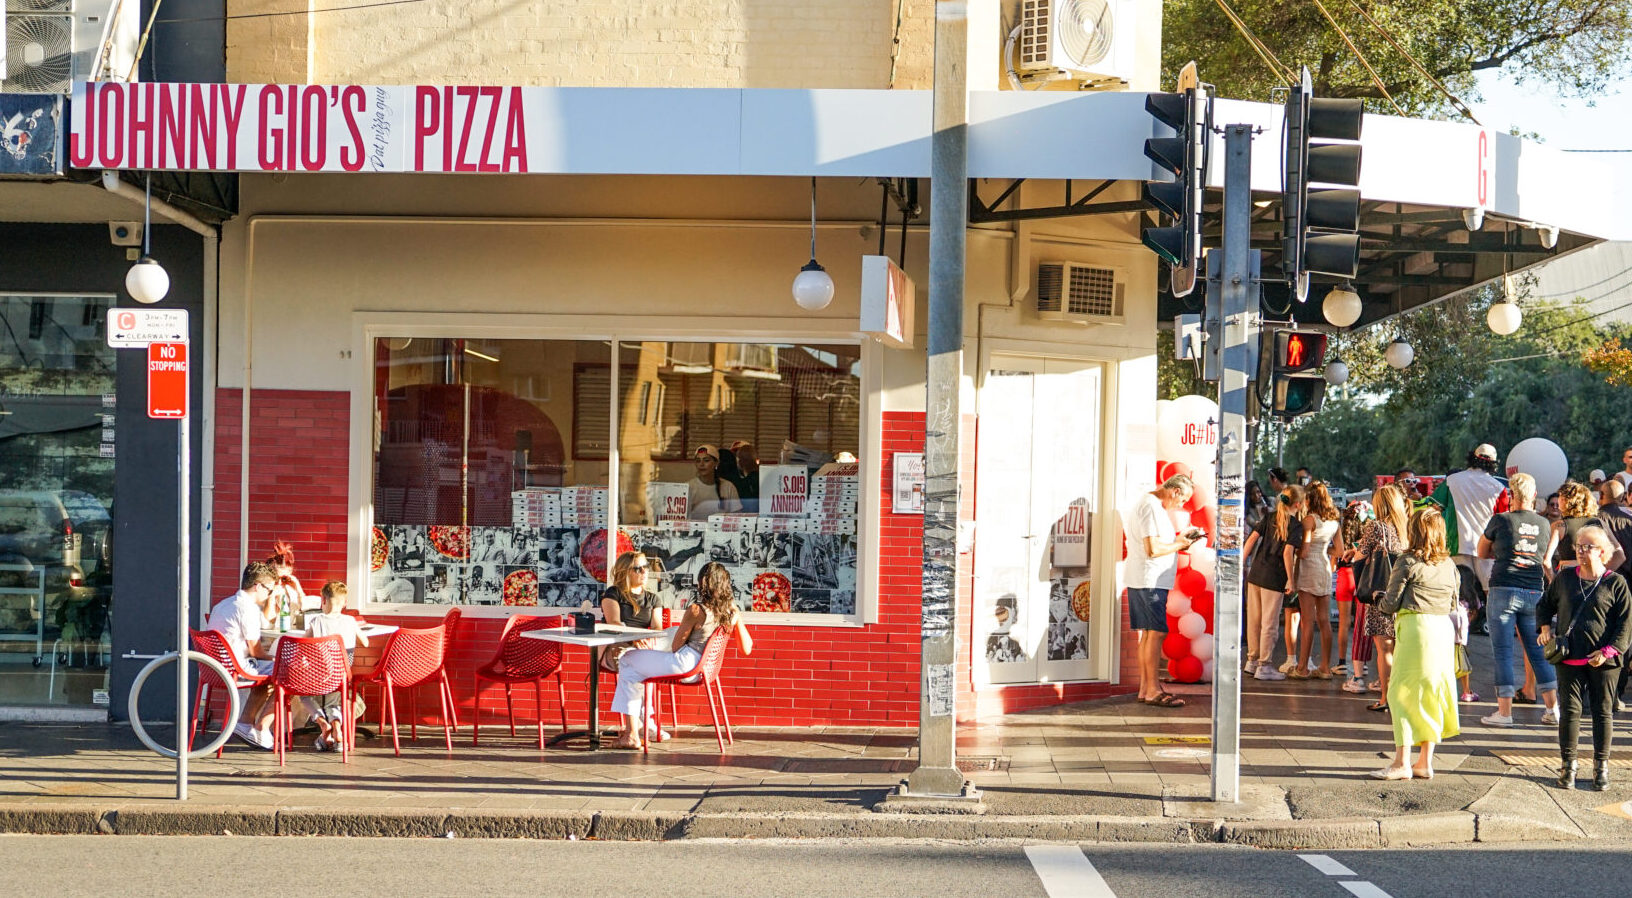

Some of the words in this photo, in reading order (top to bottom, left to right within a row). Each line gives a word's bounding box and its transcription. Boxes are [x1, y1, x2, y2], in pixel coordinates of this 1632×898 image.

[375, 86, 393, 116] guy
[71, 82, 247, 169] JOHNNY
[258, 84, 366, 171] GIO'S
[371, 112, 390, 144] pizza
[414, 86, 528, 172] PIZZA
[150, 361, 186, 371] STOPPING
[160, 346, 176, 358] NO
[770, 494, 806, 513] JOHNNY
